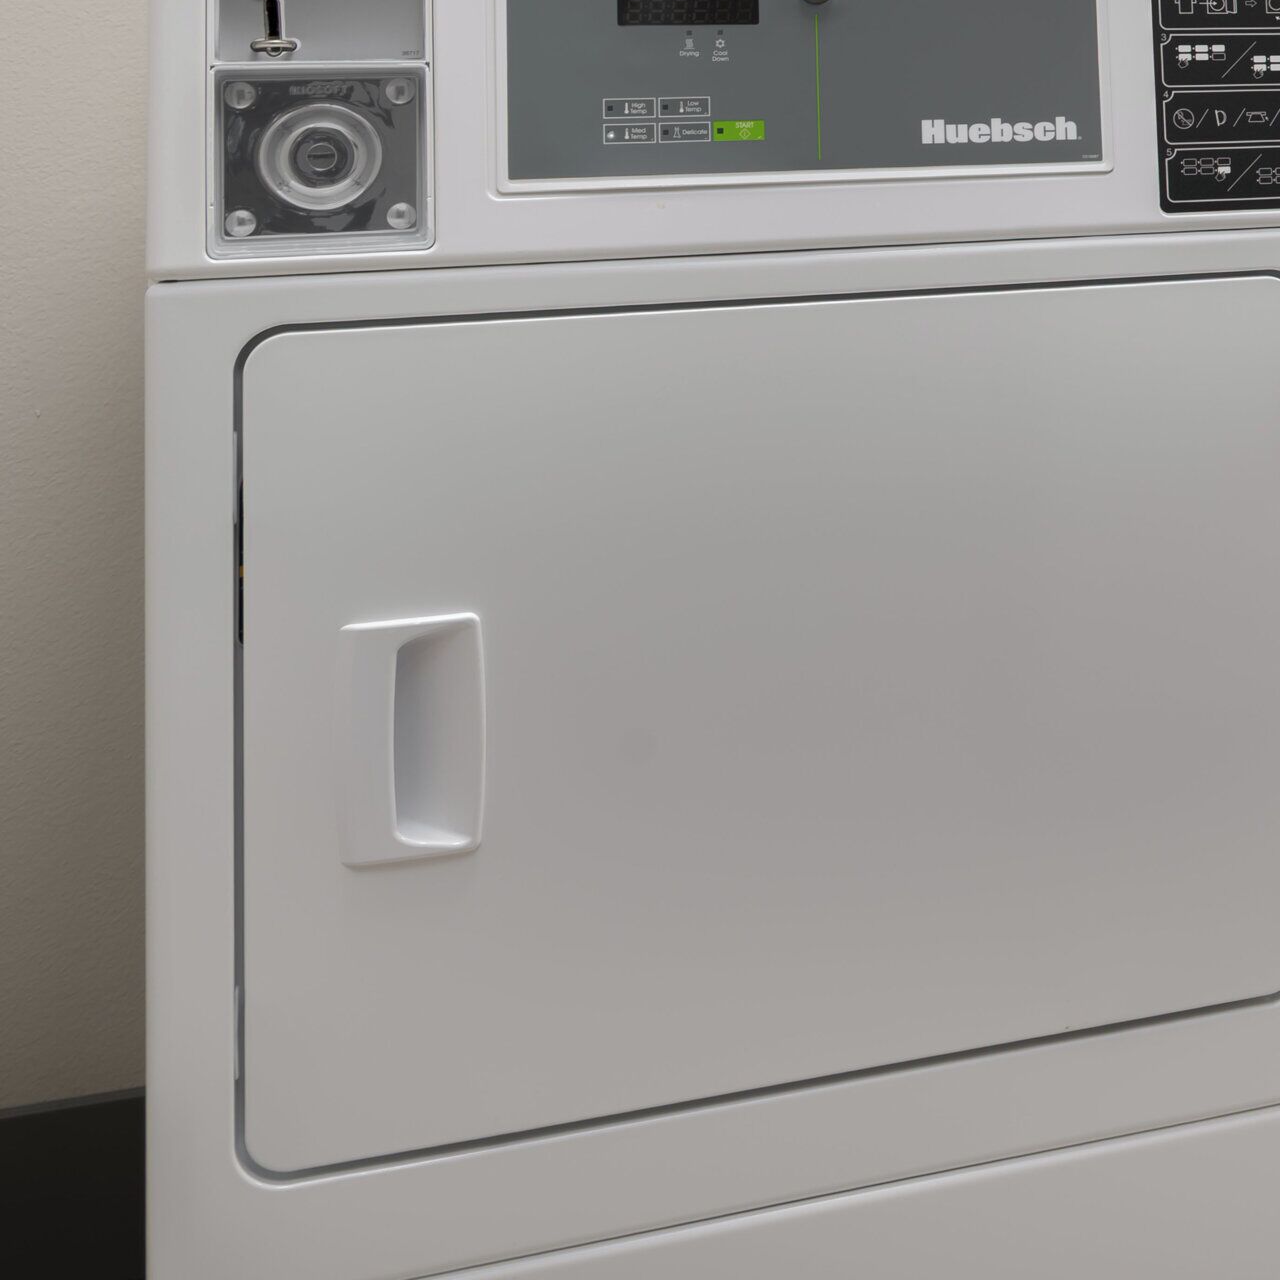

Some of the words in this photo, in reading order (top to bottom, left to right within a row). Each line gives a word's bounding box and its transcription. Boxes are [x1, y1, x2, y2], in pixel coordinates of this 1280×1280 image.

[1161, 33, 1167, 41] 3
[921, 116, 1078, 144] Huebsch
[1166, 148, 1172, 156] 5
